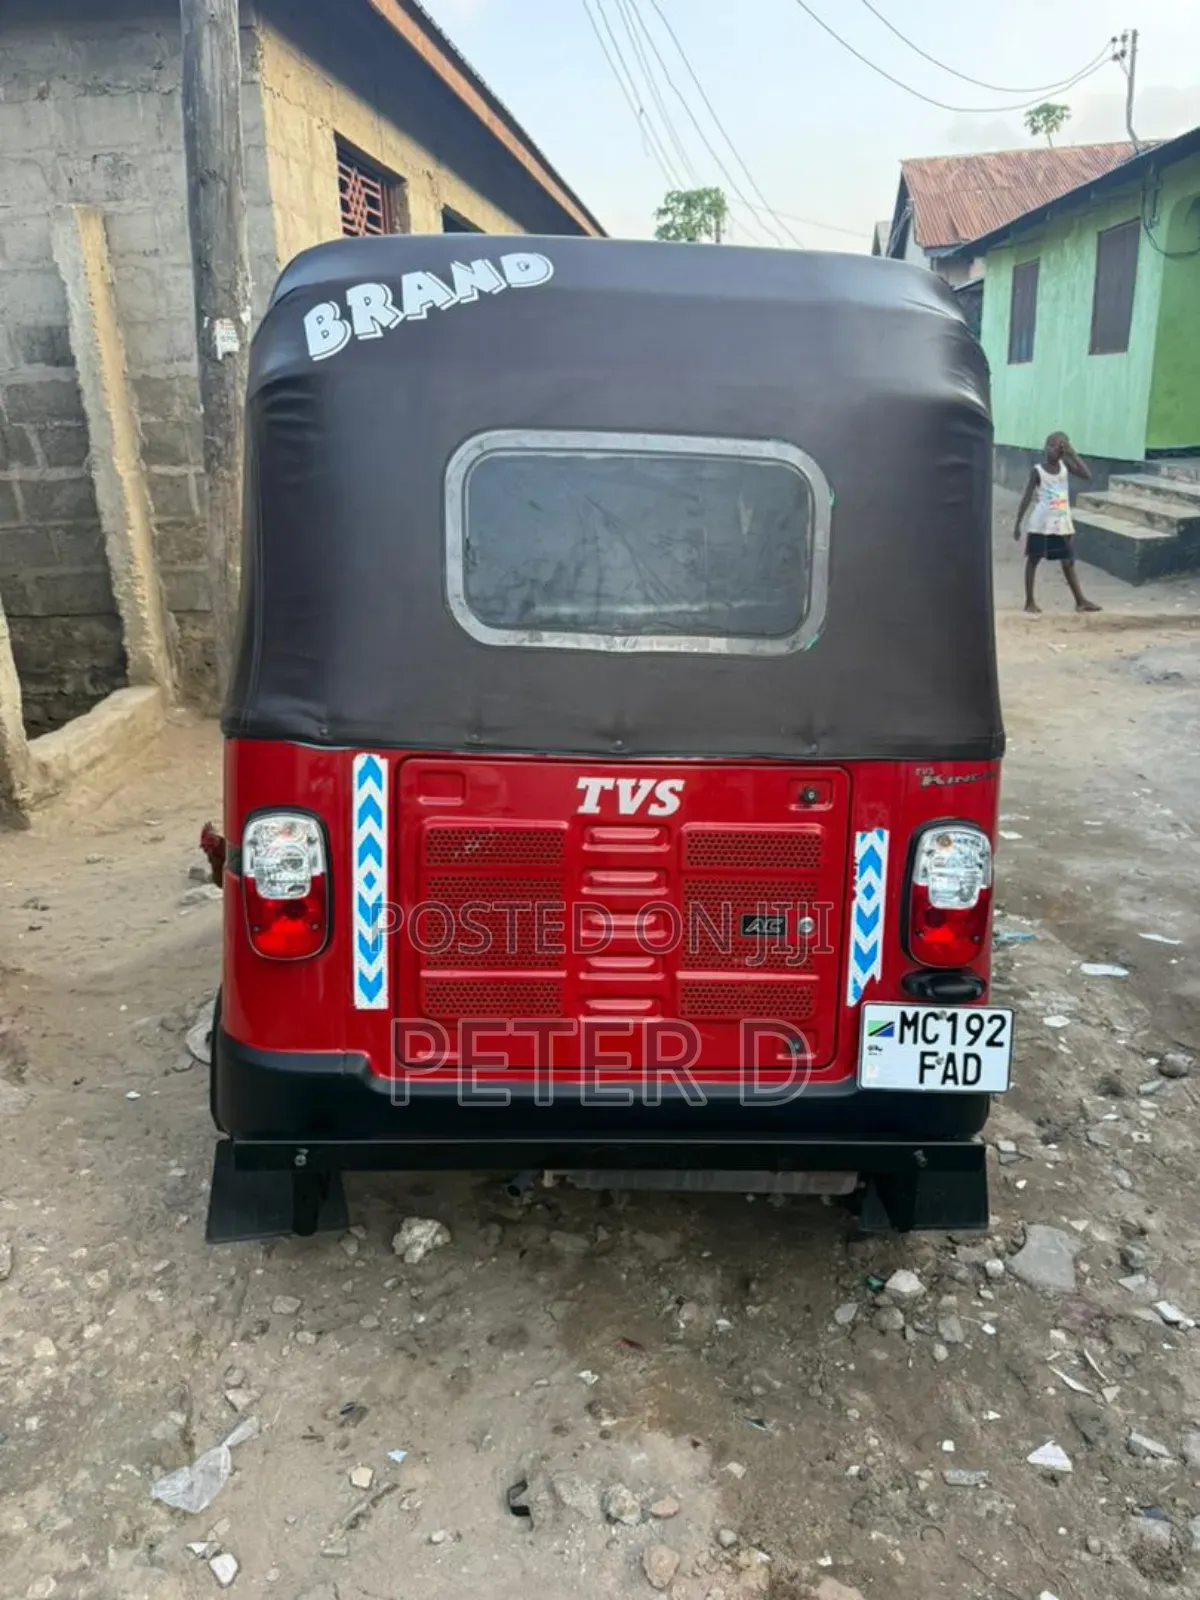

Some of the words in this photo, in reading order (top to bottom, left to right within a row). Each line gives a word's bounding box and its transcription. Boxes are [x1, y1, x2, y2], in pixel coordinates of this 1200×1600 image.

[303, 252, 554, 361] BRAND
[576, 777, 685, 816] TVS
[898, 1010, 1007, 1047] MC192
[919, 1051, 982, 1085] FAD
